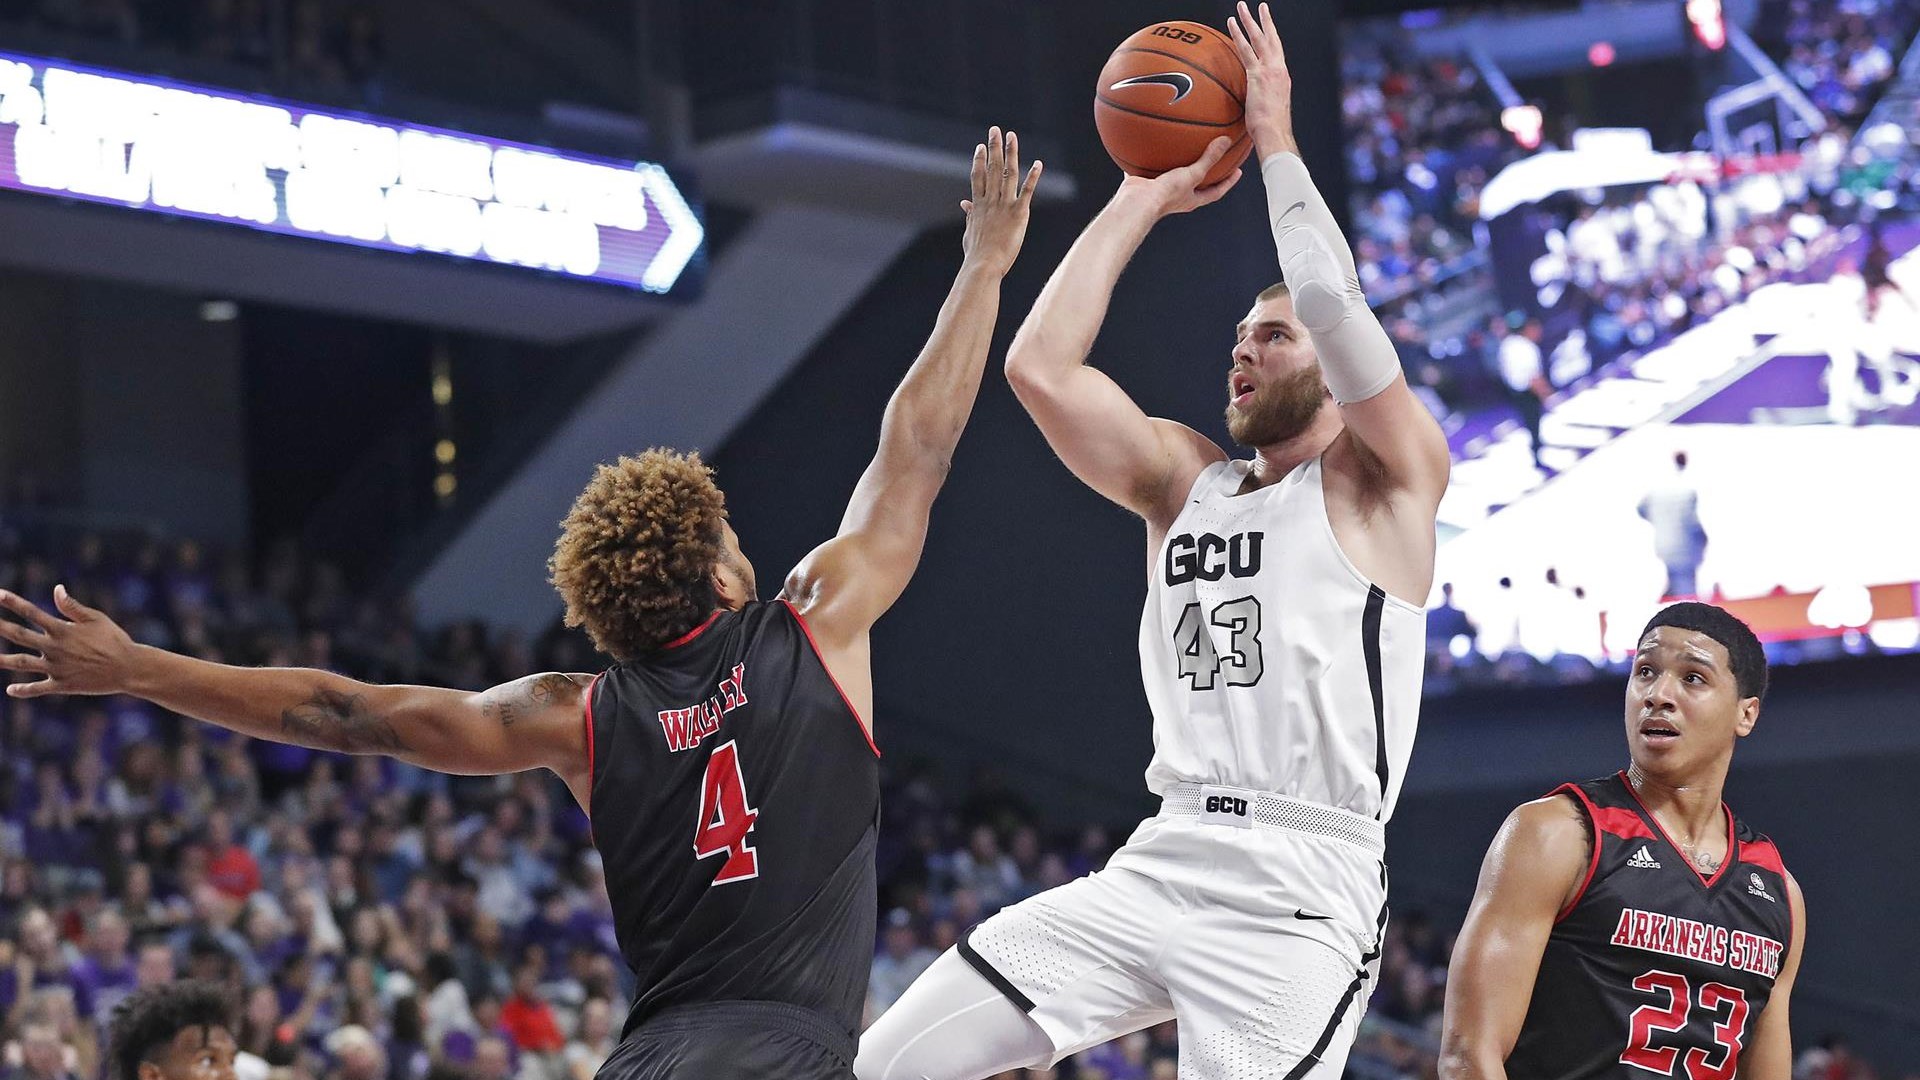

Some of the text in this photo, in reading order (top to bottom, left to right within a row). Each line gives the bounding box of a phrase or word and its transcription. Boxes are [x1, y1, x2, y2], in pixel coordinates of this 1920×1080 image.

[1151, 26, 1203, 45] GCU
[1165, 531, 1264, 587] GCU
[1173, 595, 1264, 691] 43
[693, 739, 759, 886] 4
[1205, 795, 1249, 817] GCU
[1626, 858, 1661, 869] adidas
[1610, 908, 1783, 979] ARKANSAS STATE
[1619, 970, 1749, 1080] 23
